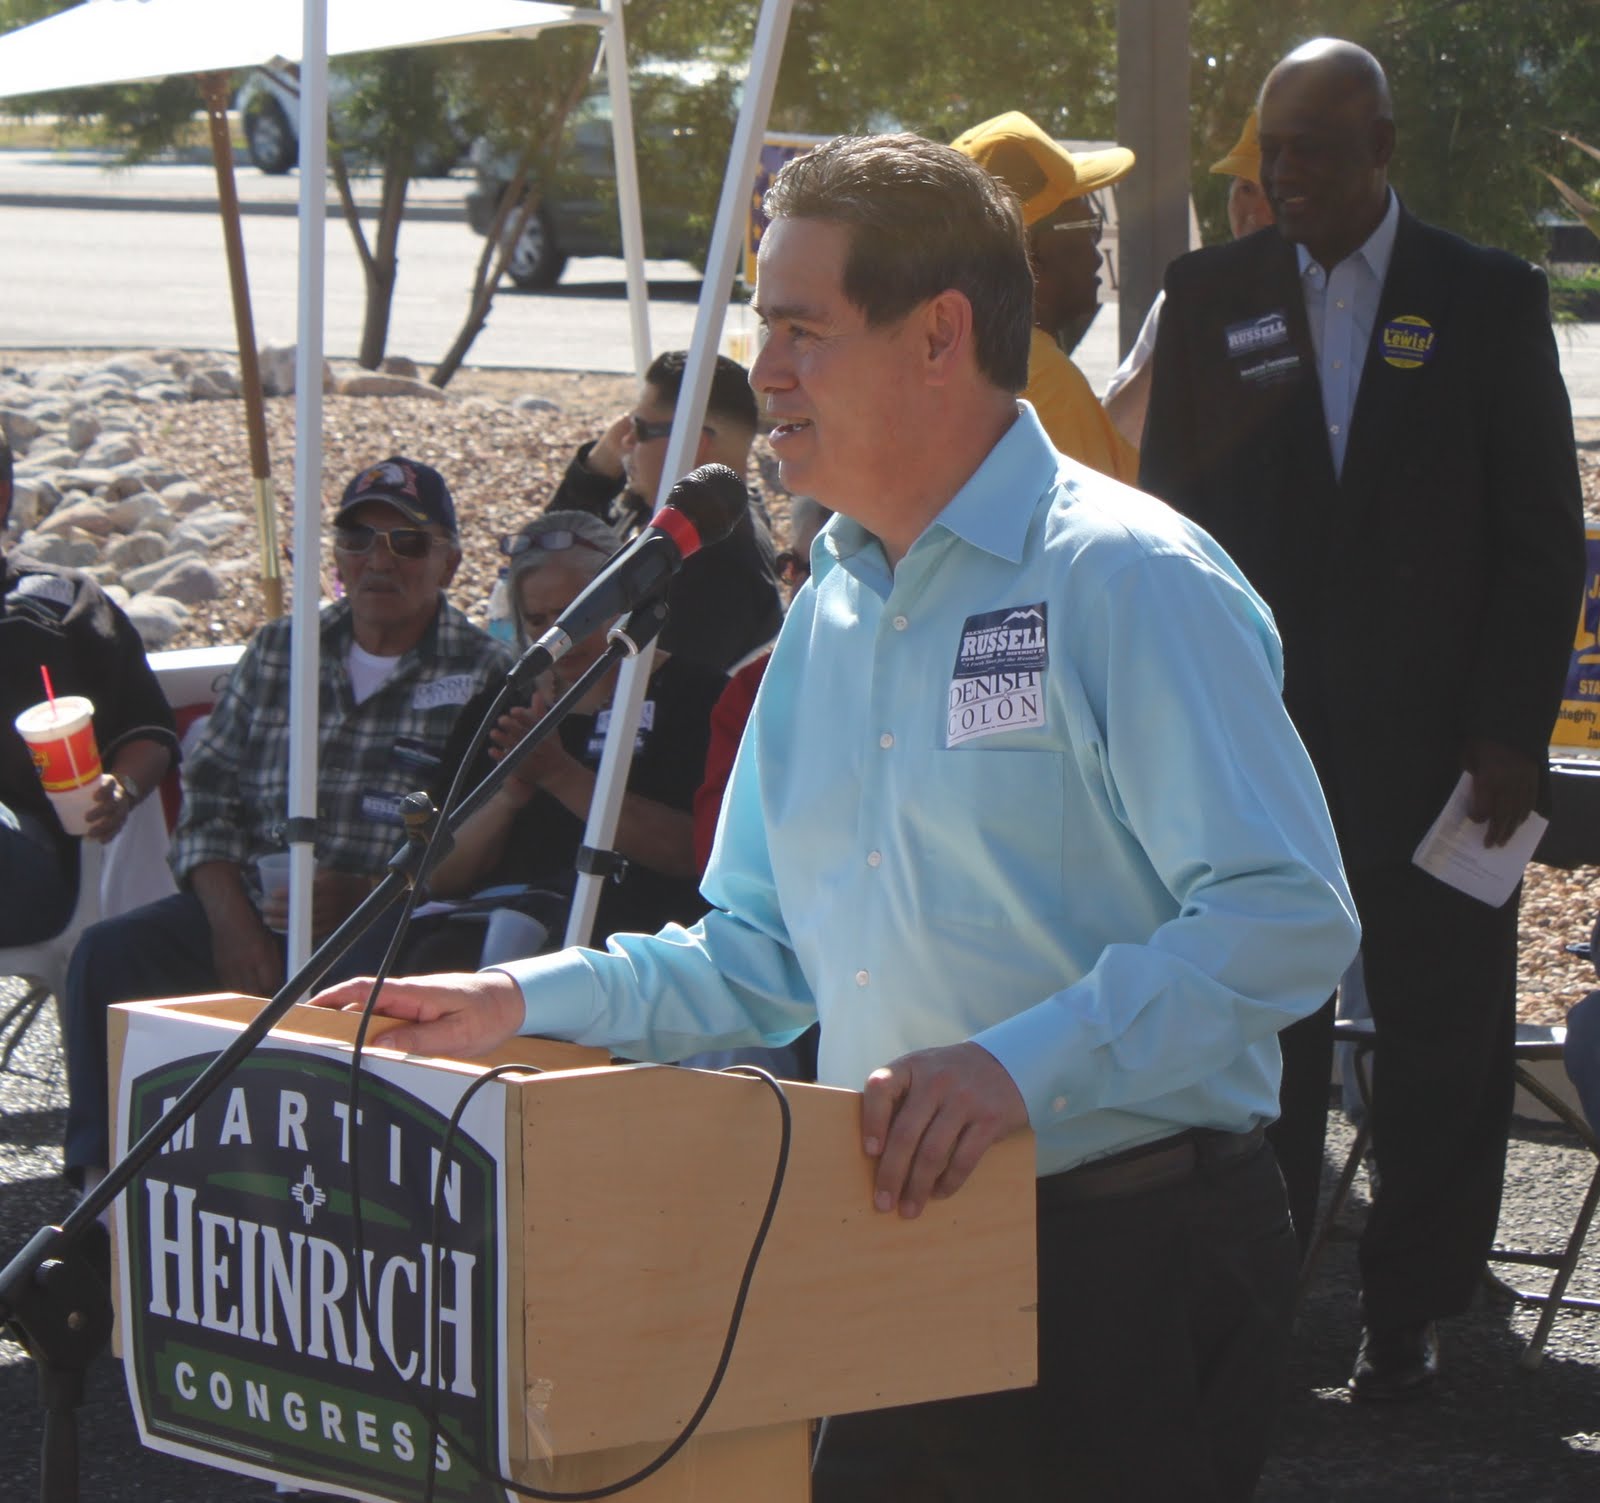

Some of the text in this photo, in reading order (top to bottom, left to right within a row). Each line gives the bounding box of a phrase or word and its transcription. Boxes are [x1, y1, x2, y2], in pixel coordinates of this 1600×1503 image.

[1227, 321, 1287, 349] RUSSELL
[1383, 328, 1435, 350] Lewis!
[961, 626, 1045, 657] RUSSELL
[949, 672, 1036, 709] DENISH
[1558, 709, 1597, 724] ntegrity
[146, 1178, 477, 1398] HEINRICH
[174, 1362, 452, 1472] CONGRESS
